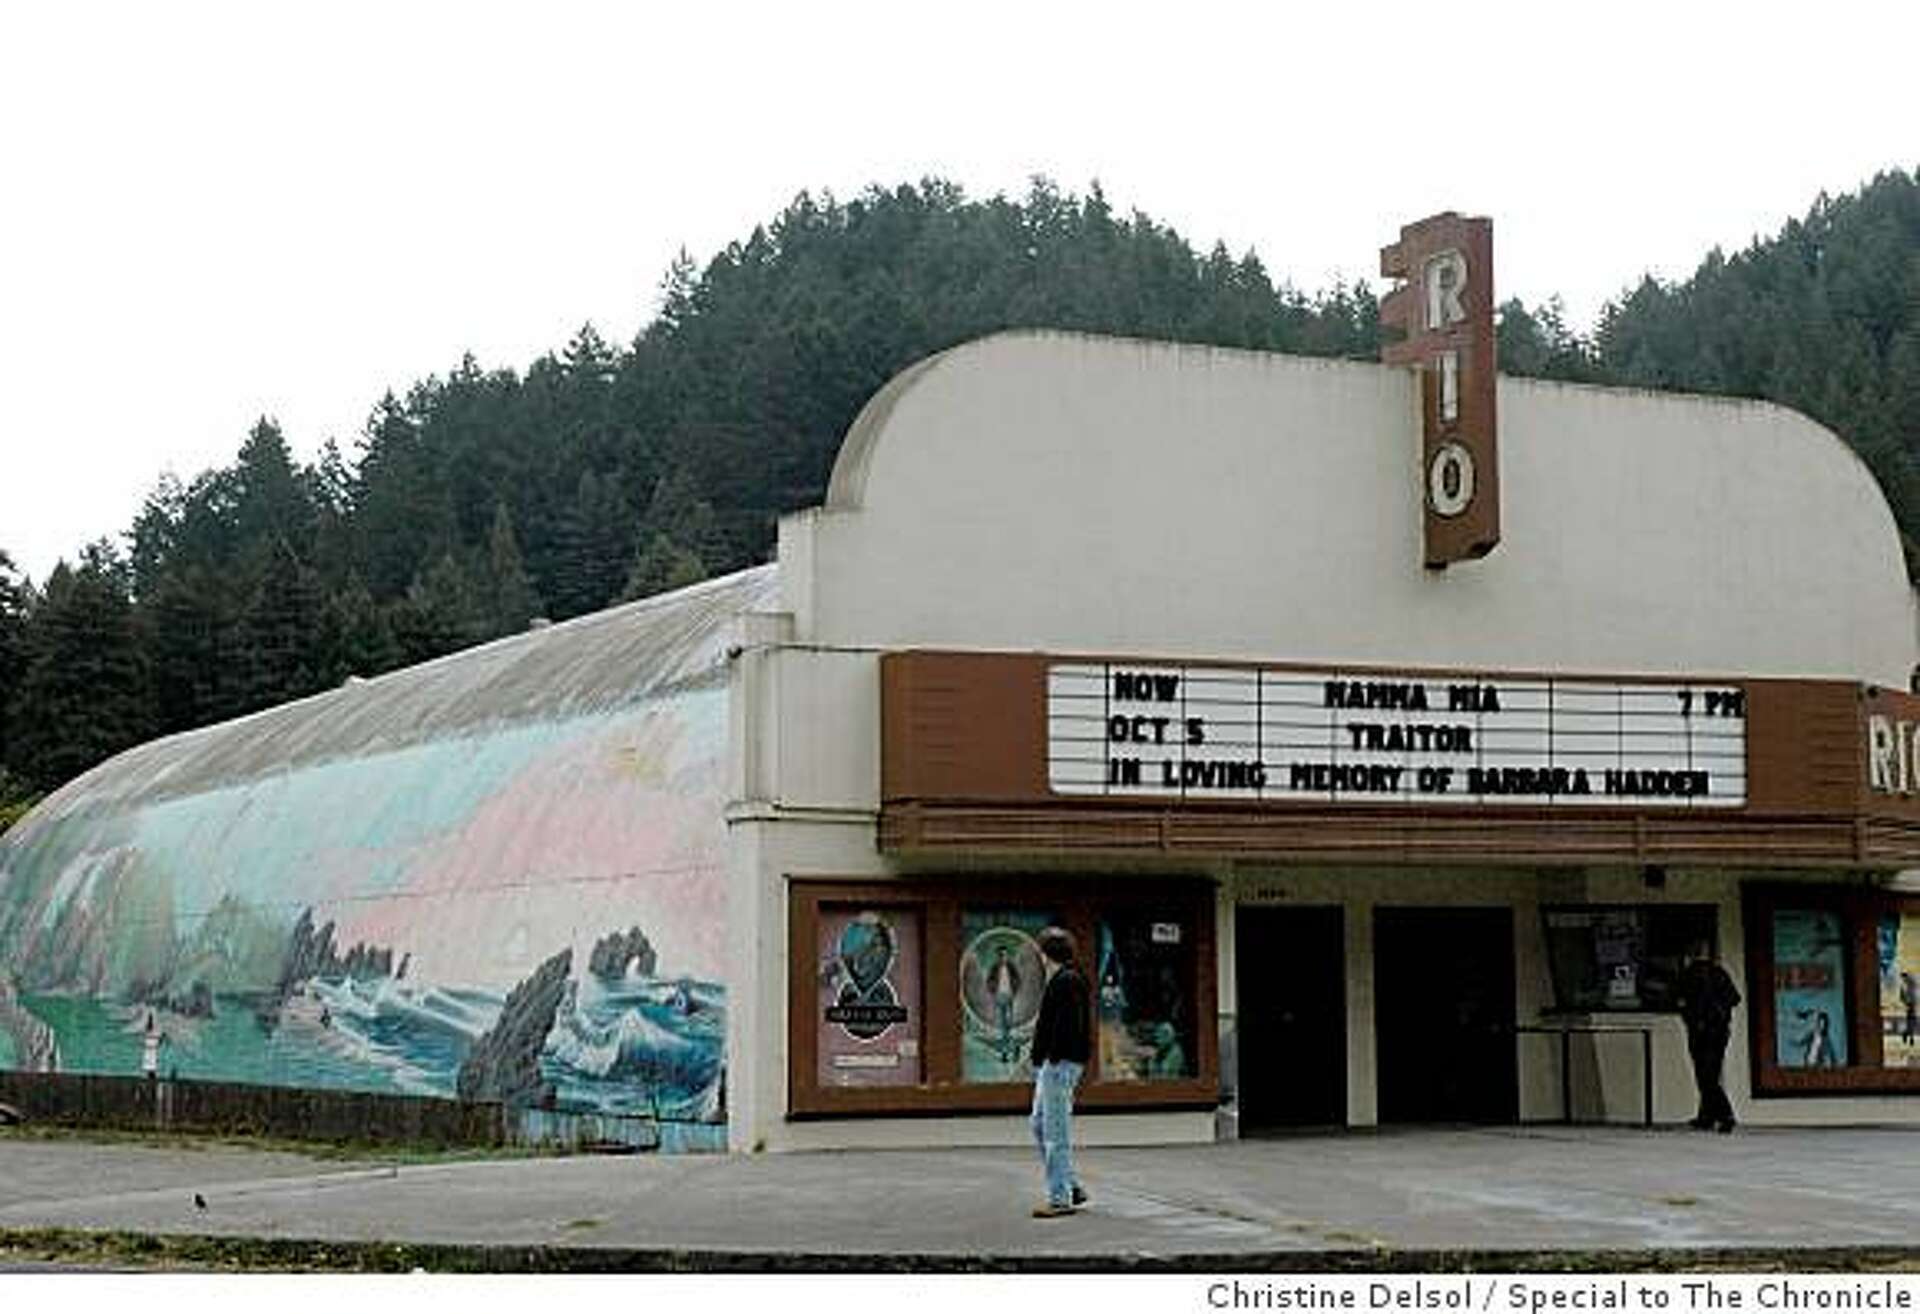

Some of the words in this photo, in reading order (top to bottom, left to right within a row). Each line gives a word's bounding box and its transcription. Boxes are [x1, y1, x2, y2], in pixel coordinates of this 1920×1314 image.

[1424, 248, 1476, 517] RIO
[1114, 673, 1179, 701] NOW
[1324, 681, 1428, 710] MAMMA
[1449, 685, 1500, 712] MIA
[1678, 691, 1692, 716] 7
[1705, 691, 1745, 717] PM
[1109, 716, 1169, 744] OCT
[1187, 717, 1204, 745] 5
[1347, 724, 1473, 752] TRAITOR
[1869, 714, 1920, 794] RI
[1109, 758, 1141, 786] IN
[1162, 760, 1266, 789] LOVING
[1290, 764, 1402, 791] MEMORY
[1418, 767, 1454, 793] OF
[1467, 767, 1592, 795] BARBARA
[1604, 769, 1709, 796] HADDEN
